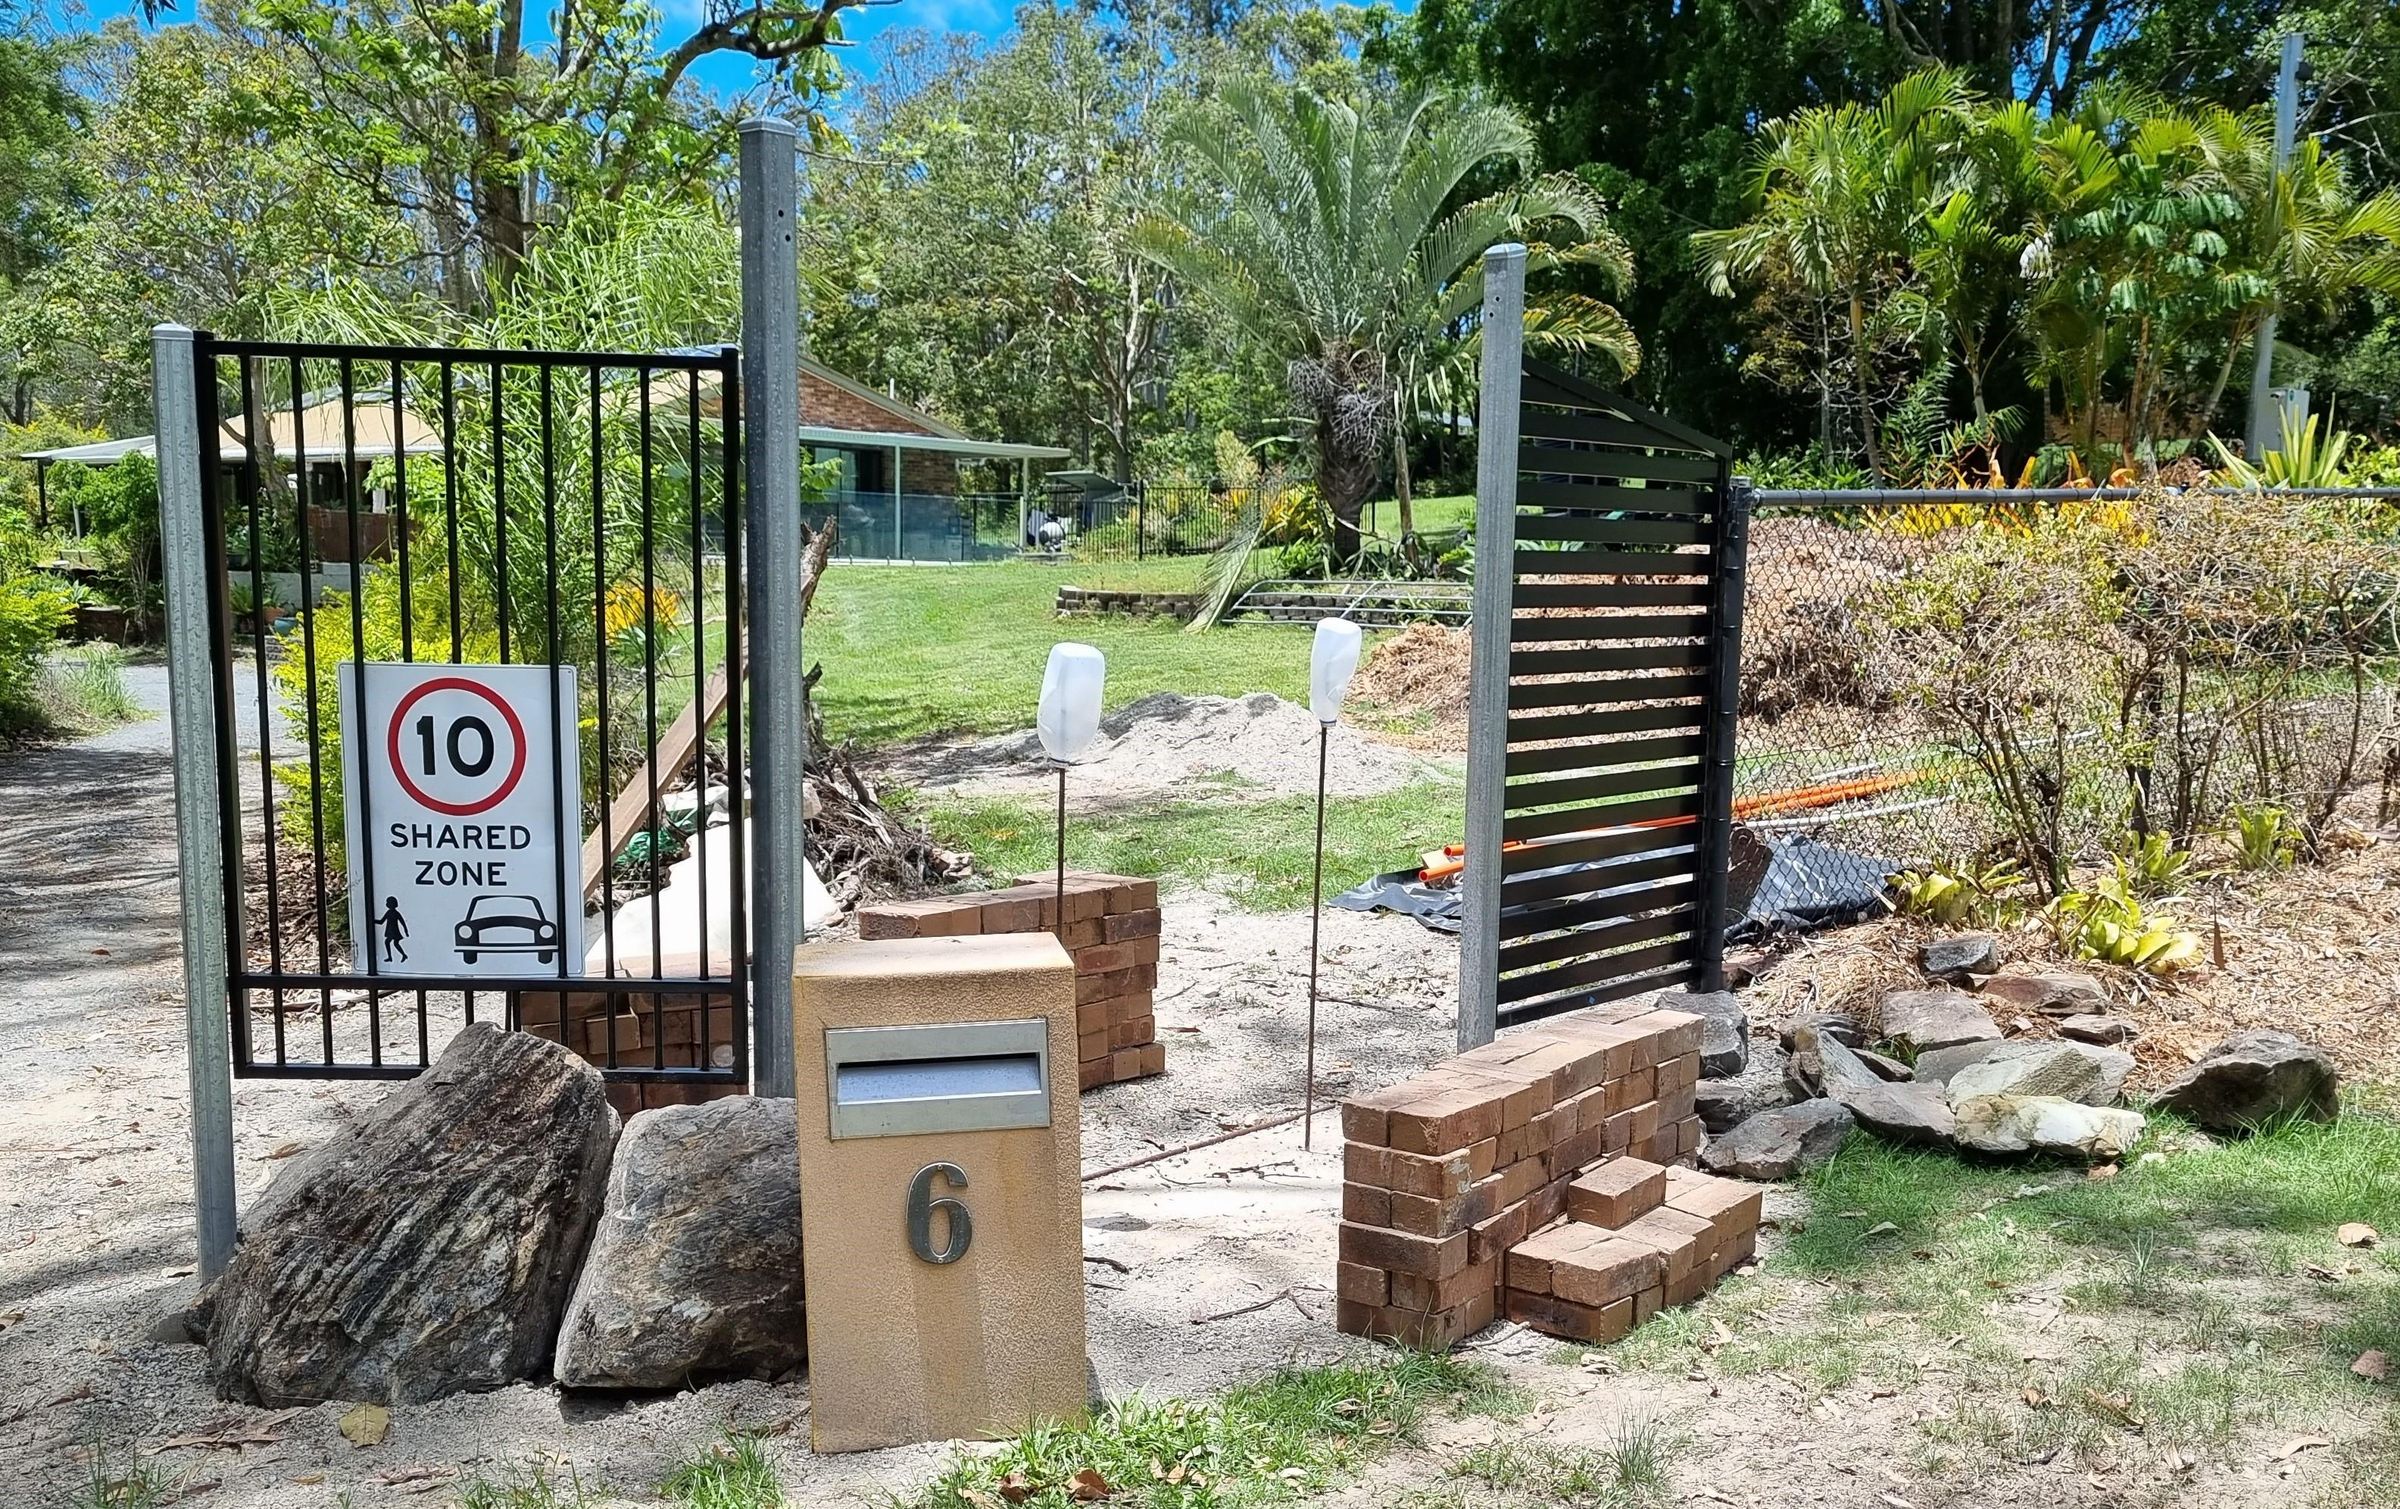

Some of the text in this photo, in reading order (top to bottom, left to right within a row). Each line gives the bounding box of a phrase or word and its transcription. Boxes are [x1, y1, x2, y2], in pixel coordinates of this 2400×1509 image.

[416, 715, 494, 777] 10
[390, 823, 531, 850] SHARED
[415, 860, 507, 886] ZONE
[907, 1161, 973, 1264] 6
